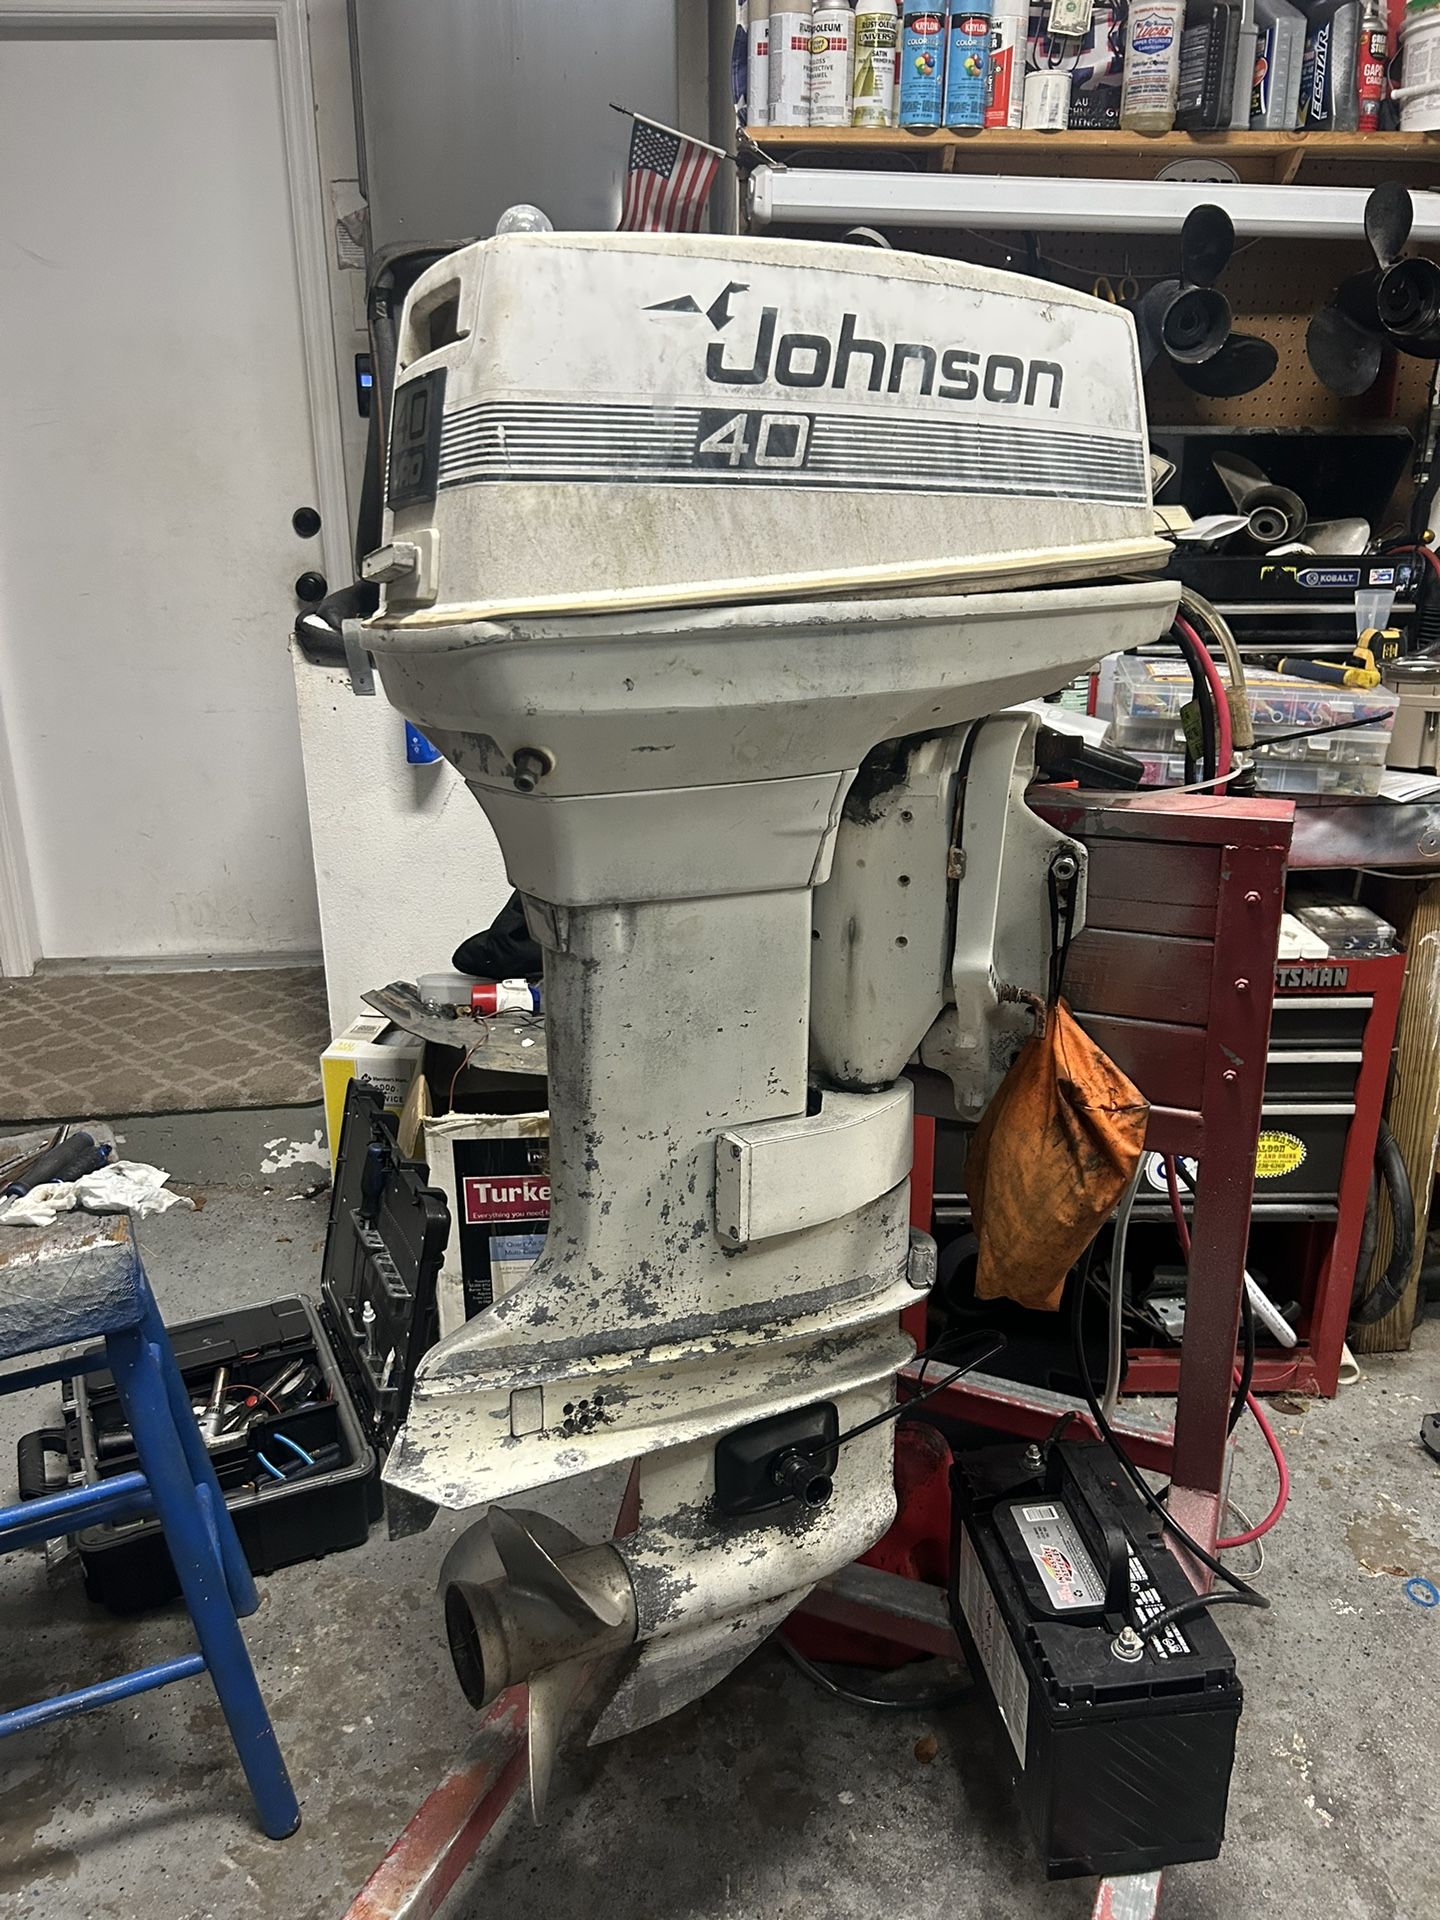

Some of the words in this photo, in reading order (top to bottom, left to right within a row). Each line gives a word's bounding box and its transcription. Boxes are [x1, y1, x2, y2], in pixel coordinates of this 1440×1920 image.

[1136, 26, 1171, 39] LUCAS
[1311, 23, 1330, 120] ECSTAR
[706, 306, 1063, 409] Johnson
[700, 412, 811, 468] 40
[1320, 574, 1354, 582] KOBALT
[1278, 967, 1348, 987] TSMAN
[384, 1095, 404, 1104] VICE
[1257, 1144, 1286, 1152] ALOON
[473, 1183, 551, 1204] Turke
[473, 1211, 510, 1219] Everything
[526, 1208, 544, 1217] need
